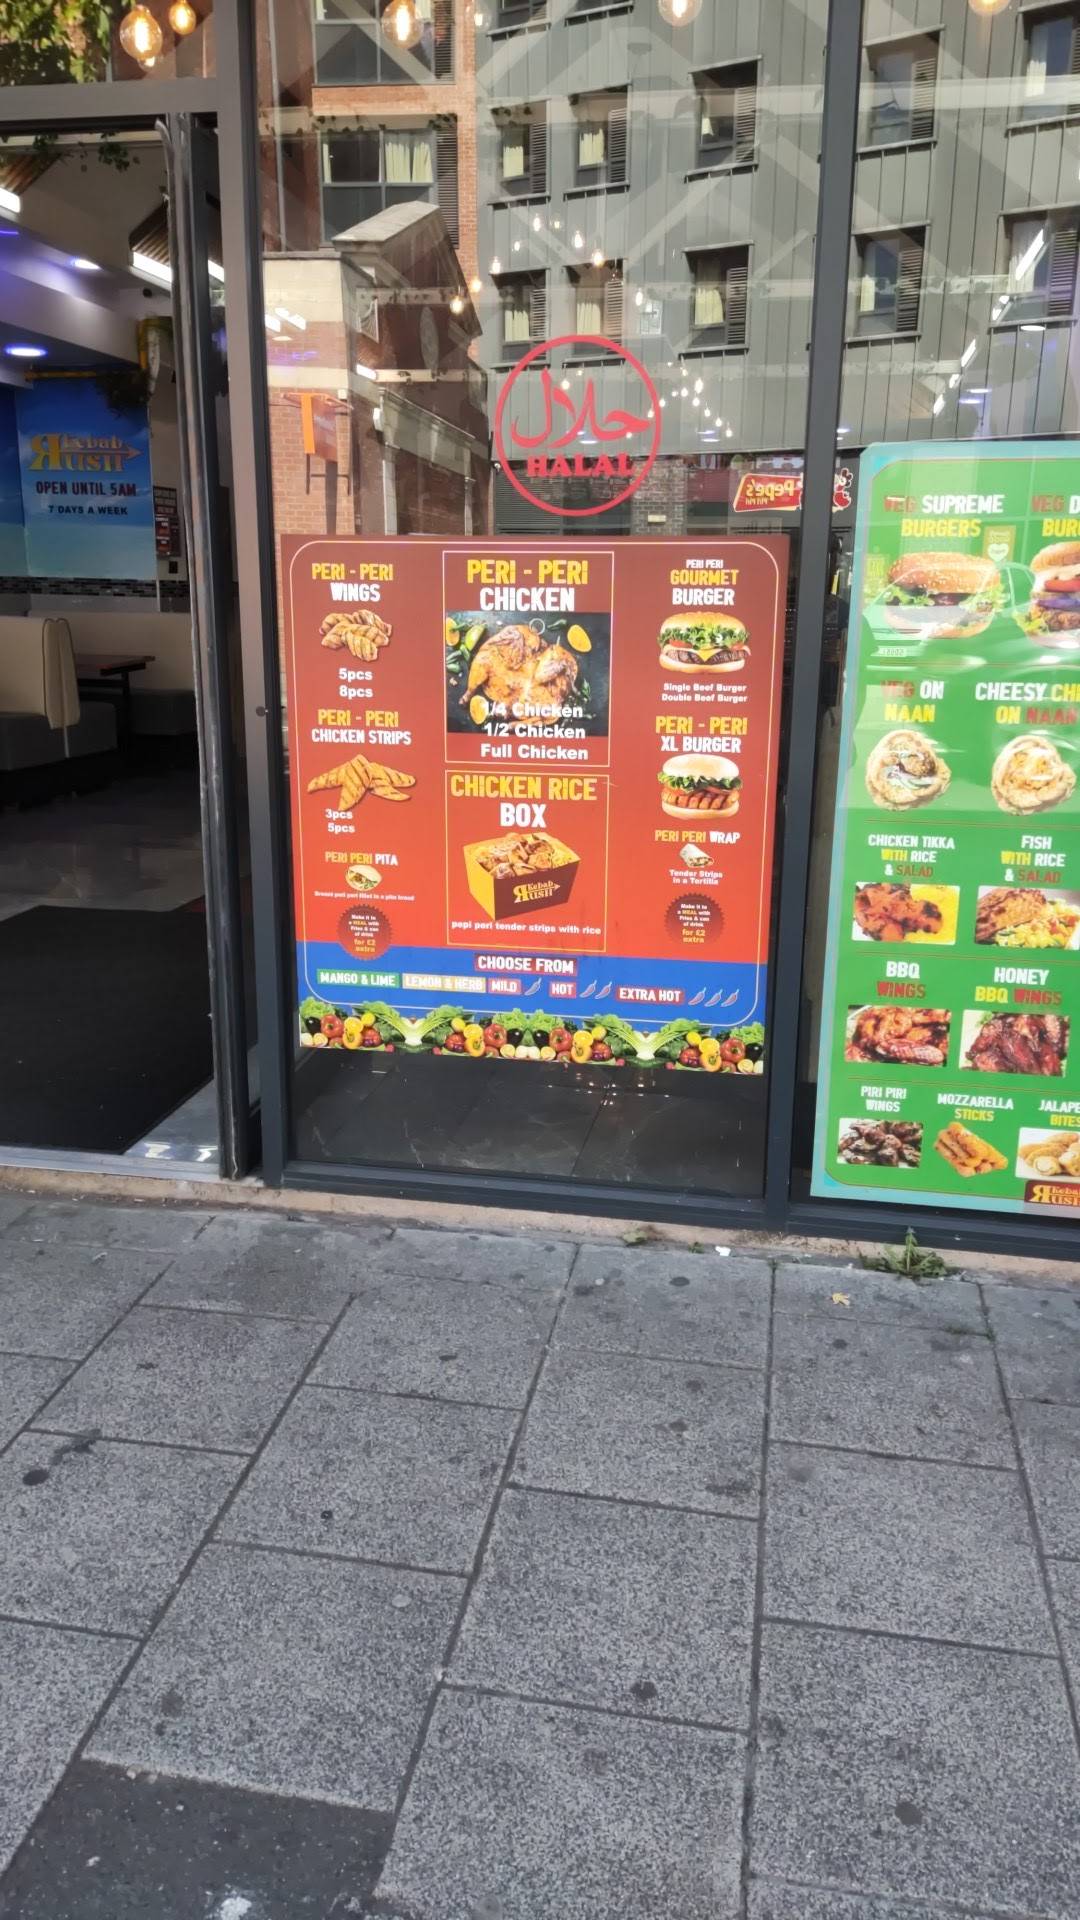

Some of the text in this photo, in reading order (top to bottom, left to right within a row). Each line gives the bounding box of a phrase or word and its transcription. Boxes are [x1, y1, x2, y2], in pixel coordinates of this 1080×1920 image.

[511, 366, 652, 449] حلال
[527, 453, 634, 478] HALAL
[36, 481, 137, 497] OPEN UNTIL 5AM
[48, 505, 54, 513] 7
[58, 506, 84, 514] DAYS
[98, 507, 128, 515] WEEK
[922, 494, 1005, 514] SUPREME
[1032, 496, 1064, 512] VEG
[901, 519, 982, 537] BURGERS
[1042, 519, 1080, 537] BUR
[312, 563, 345, 580] PERI
[360, 563, 394, 581] PERI
[467, 559, 516, 584] PERI
[539, 560, 588, 584] PERI
[686, 559, 724, 569] PERI PERI
[670, 570, 739, 586] GOURMET
[330, 582, 381, 602] WINGS
[480, 587, 575, 612] CHICKEN
[672, 588, 735, 605] BURGER
[339, 668, 373, 683] 5pcs
[339, 685, 374, 700] 8pcs
[664, 683, 748, 693] Single Beef Burger
[920, 680, 945, 699] ON
[976, 682, 1047, 701] CHEESY
[661, 693, 748, 703] Double Beef Burger
[318, 709, 351, 726] PERI
[365, 710, 399, 728] PERI
[512, 703, 584, 718] Chicken
[884, 703, 936, 723] NAAN
[996, 706, 1077, 725] ON NAAN
[484, 723, 586, 739] 1/2 Chicken
[656, 715, 693, 734] PERI
[710, 716, 747, 735] PERI
[312, 728, 412, 745] CHICKEN STRIPS
[661, 736, 741, 753] XL BURGER
[481, 743, 589, 760] Full Chicken
[451, 774, 598, 801] CHICKEN RICE
[325, 808, 353, 821] 3pcs
[500, 803, 547, 828] BOX
[328, 823, 355, 834] 5pcs
[655, 830, 740, 844] PERI PERI WRAP
[868, 834, 955, 850] CHICKEN TIKKA
[1021, 835, 1052, 850] FISH
[325, 852, 398, 866] PERI PERI PITA
[881, 849, 937, 863] WITH RICE
[1001, 851, 1066, 867] WITH RICE
[669, 869, 723, 879] Tender Strips
[885, 864, 934, 878] & SALAD
[1004, 868, 1061, 884] & SALAD
[690, 877, 718, 885] Tortilla
[474, 921, 493, 930] peri
[495, 922, 526, 931] tender
[529, 925, 556, 934] strips
[558, 926, 579, 934] with
[583, 927, 602, 935] rice
[477, 956, 574, 974] CHOOSE FROM
[886, 961, 920, 979] BBQ
[320, 972, 396, 987] MANGO & LIME
[406, 975, 442, 988] LEMON
[455, 977, 483, 991] HERB
[994, 967, 1050, 986] HONEY
[491, 980, 518, 993] MILD
[552, 983, 573, 995] HOT
[619, 987, 681, 1002] EXTRA HOT
[876, 981, 926, 999] WINGS
[975, 986, 1062, 1006] BBQ WINGS
[861, 1086, 907, 1100] PIRI PIRI
[865, 1099, 900, 1112] WINGS
[938, 1093, 1014, 1110] MOZZARELLA
[955, 1108, 995, 1122] STICKS
[1052, 1186, 1080, 1195] Keba
